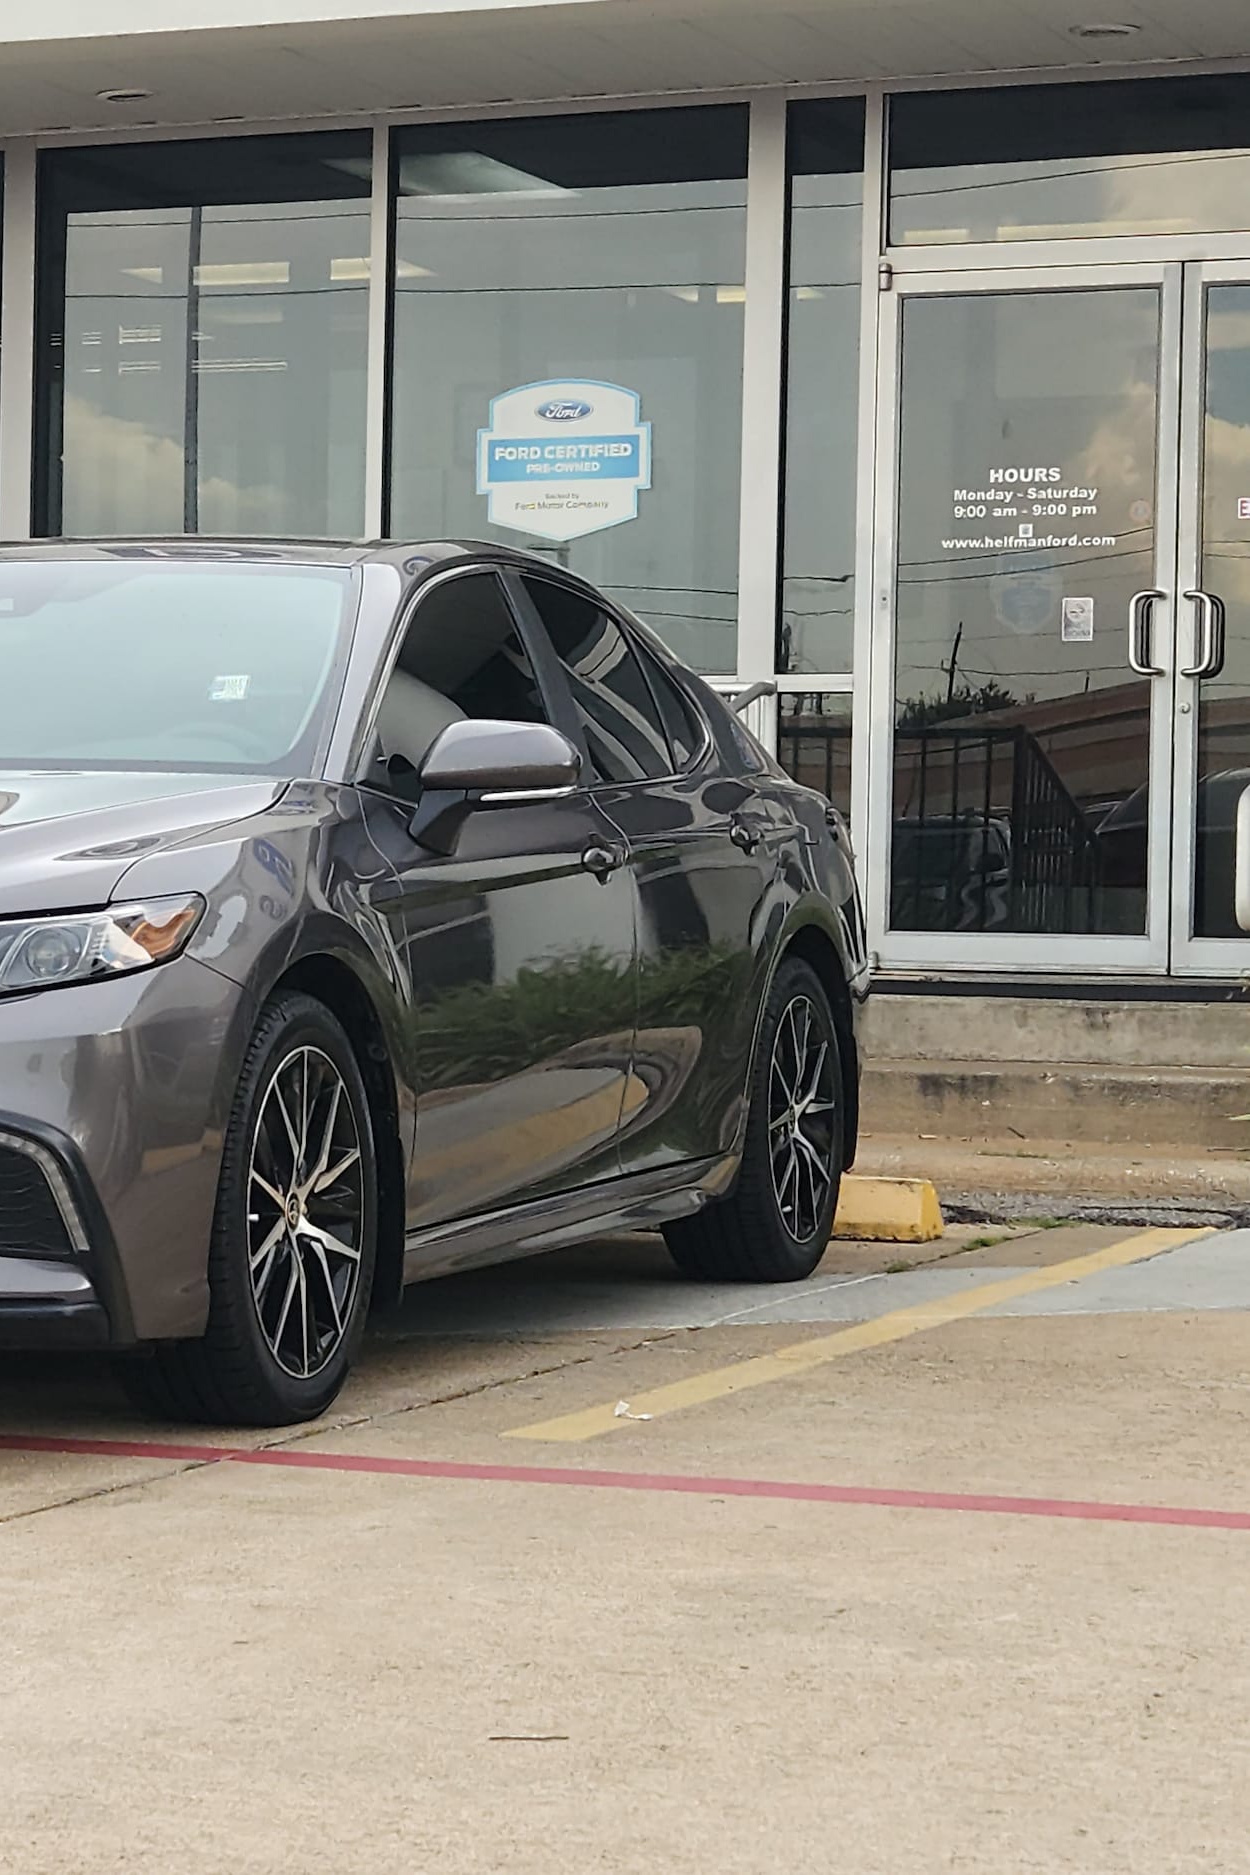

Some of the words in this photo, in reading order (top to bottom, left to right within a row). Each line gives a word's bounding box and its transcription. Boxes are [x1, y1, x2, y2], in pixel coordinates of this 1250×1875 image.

[546, 402, 582, 418] Ford
[494, 446, 541, 461] FORD
[544, 443, 632, 459] CERTIFIED
[526, 462, 600, 474] PRE-OWNED
[989, 467, 1061, 483] HOURS
[953, 488, 1013, 503] Monday
[1026, 487, 1097, 501] Saturday
[537, 501, 564, 510] Motor
[566, 500, 609, 510] Company
[954, 505, 986, 518] 9:00
[992, 506, 1017, 517] am
[1032, 503, 1067, 516] 9:00
[1071, 504, 1097, 517] pm
[941, 534, 1116, 549] www.helfmanford.com
